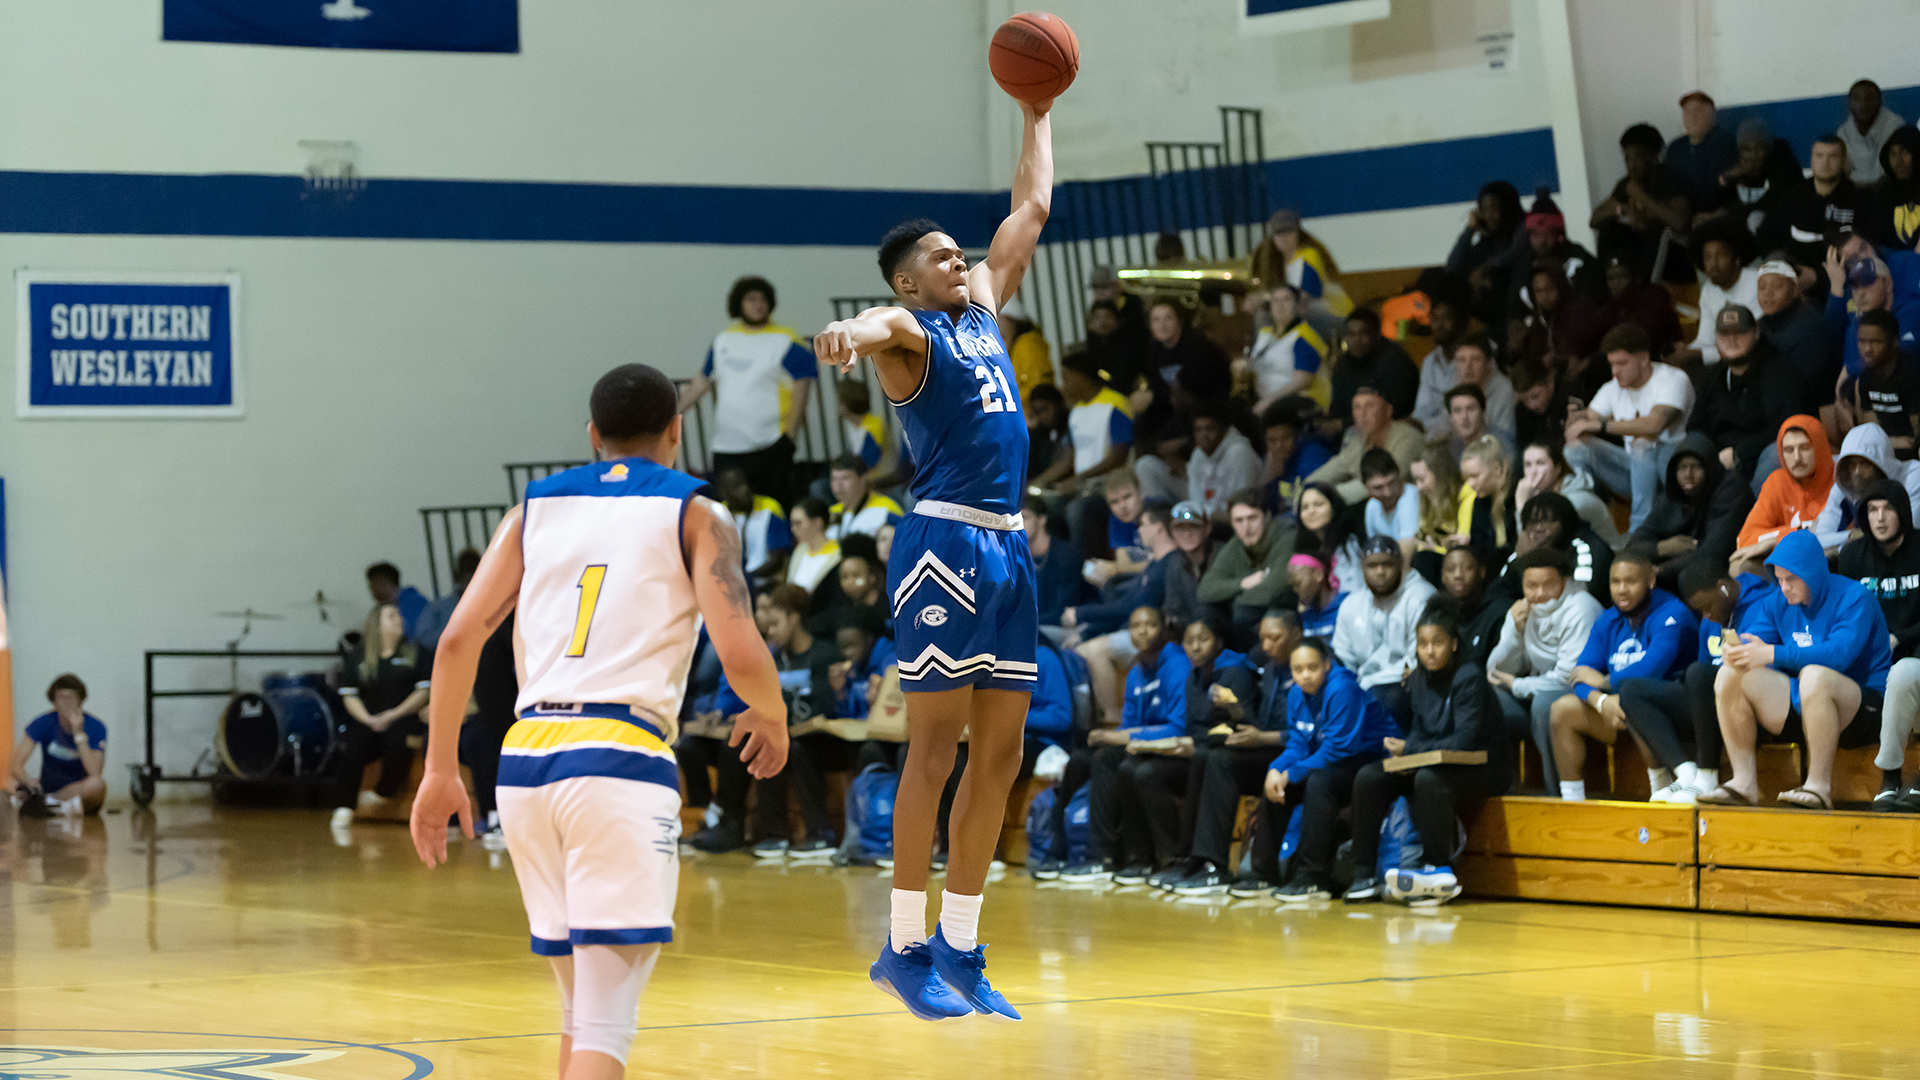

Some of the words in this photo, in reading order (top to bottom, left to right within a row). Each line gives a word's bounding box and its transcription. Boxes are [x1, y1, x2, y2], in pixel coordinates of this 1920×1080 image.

[50, 303, 212, 341] SOUTHERN
[50, 349, 213, 387] WESLEYAN
[974, 365, 1018, 414] 21
[940, 506, 1003, 526] ARMOUR
[565, 564, 608, 658] 1
